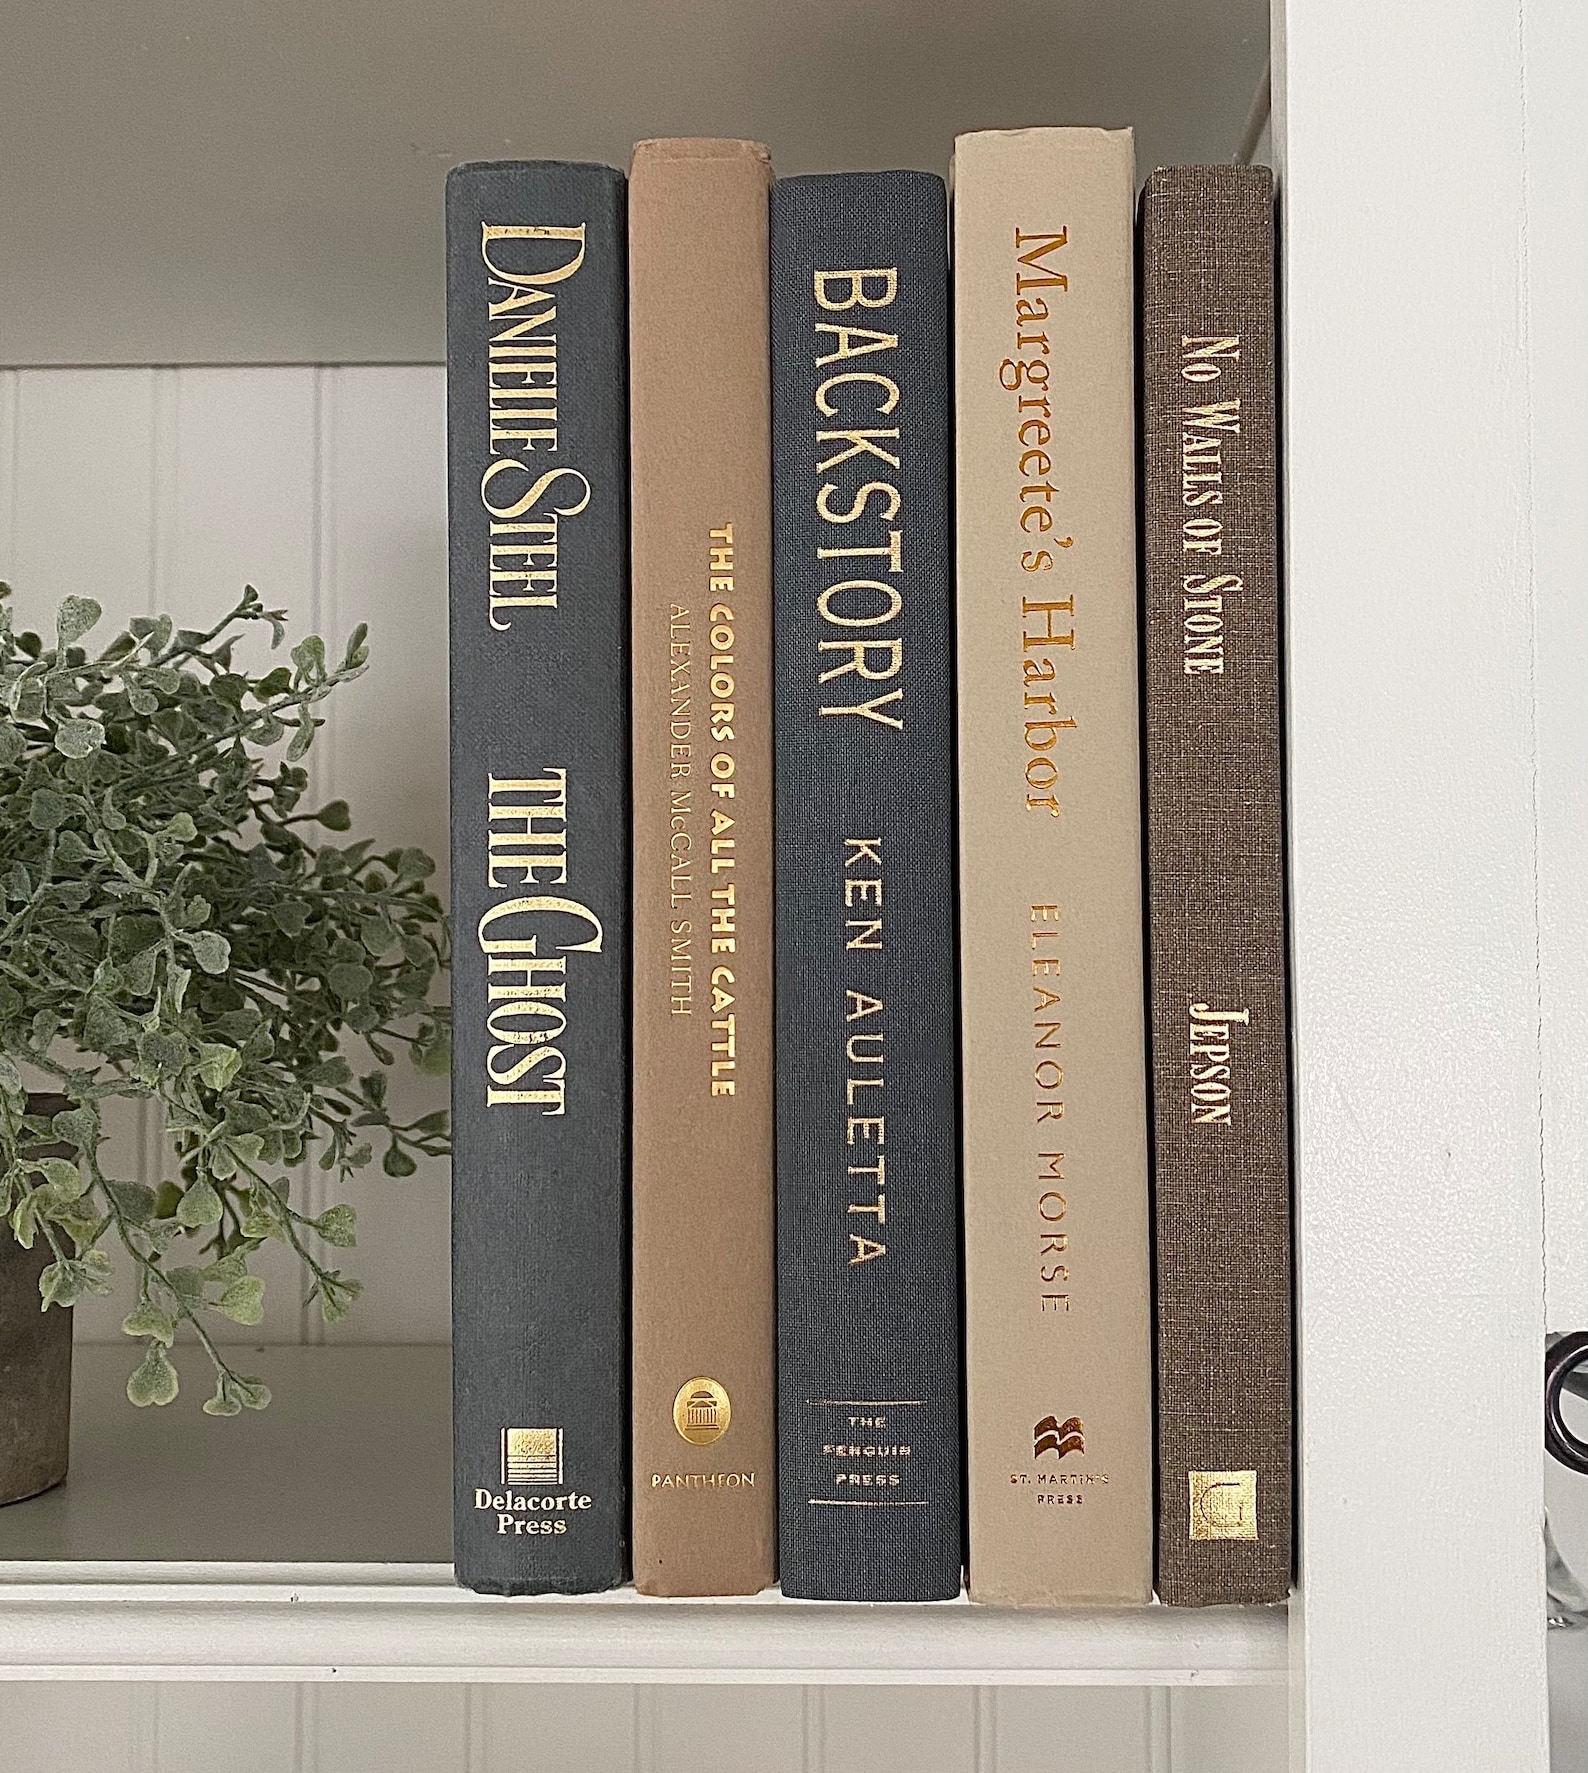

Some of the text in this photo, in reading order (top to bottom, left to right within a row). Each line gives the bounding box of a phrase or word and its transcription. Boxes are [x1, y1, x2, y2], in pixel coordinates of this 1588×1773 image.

[481, 221, 591, 631] DANIELLE STEEL
[1182, 398, 1241, 506] WALLS
[813, 267, 904, 730] BACKSTORY
[999, 226, 1077, 819] Margreete's Harbor
[1183, 574, 1244, 675] STONE
[670, 603, 692, 1016] ALEXANDER McCALL SMITH
[709, 522, 736, 1097] THE COLORS OF ALL THE CATTLE
[477, 768, 603, 1116] THE GHOST
[843, 837, 887, 1266] KEN AULETTA
[1189, 1002, 1250, 1126] JEPSON
[1031, 904, 1070, 1312] ELEANOR MORSE
[822, 1444, 912, 1457] PENGUIN
[847, 1416, 887, 1429] THE
[474, 1488, 592, 1511] Delacorte
[496, 1513, 567, 1535] Press
[651, 1472, 756, 1489] PANTHEON
[836, 1473, 900, 1486] PRESS
[1010, 1474, 1109, 1485] ST. MARTIN'S
[1037, 1494, 1083, 1505] PRESS
